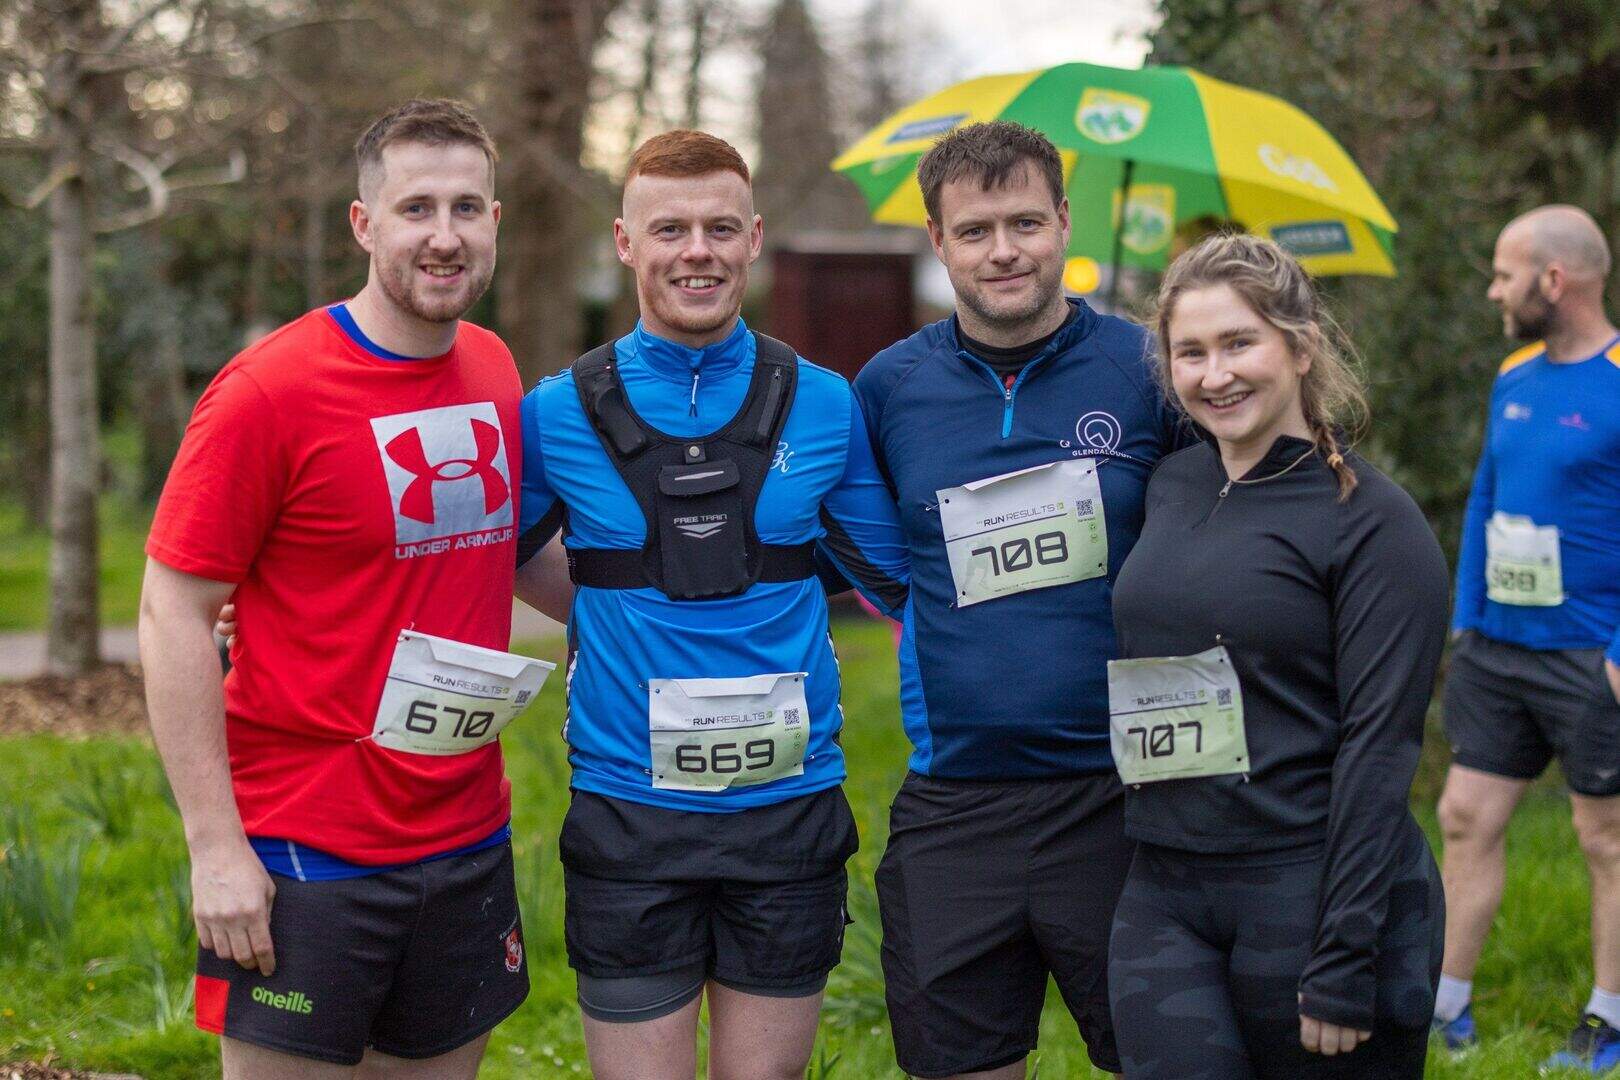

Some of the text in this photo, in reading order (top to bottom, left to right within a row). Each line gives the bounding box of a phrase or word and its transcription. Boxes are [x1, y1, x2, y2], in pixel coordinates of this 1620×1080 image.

[395, 528, 513, 559] UNDER ARMOUR
[971, 531, 1068, 576] 708
[405, 700, 495, 738] 670
[675, 738, 775, 773] 669
[1127, 721, 1202, 759] 707
